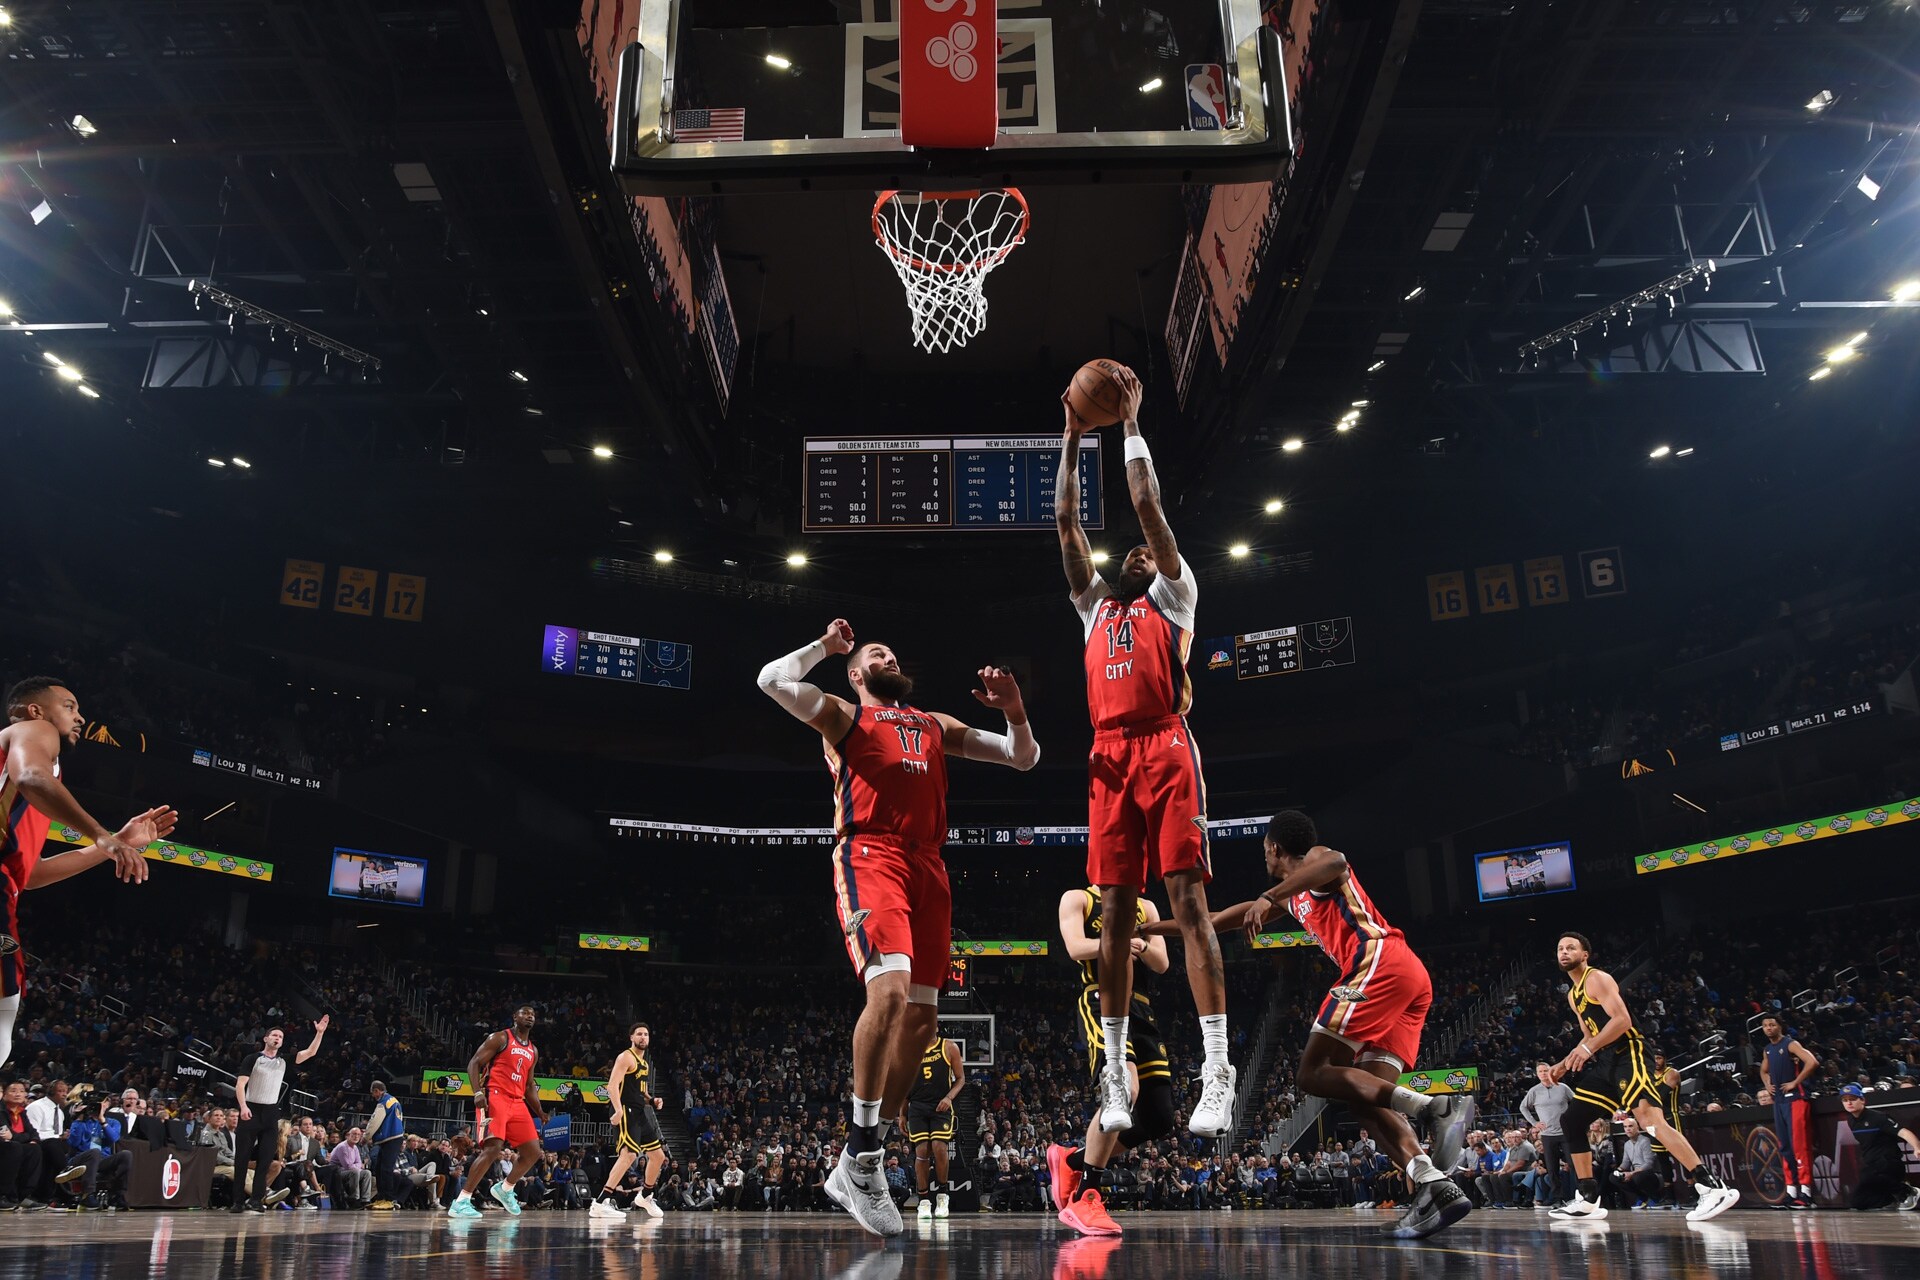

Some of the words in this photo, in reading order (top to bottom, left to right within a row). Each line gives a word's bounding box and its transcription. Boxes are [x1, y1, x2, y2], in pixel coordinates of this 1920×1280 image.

[1195, 116, 1215, 128] NBA
[849, 503, 866, 511] 50.0
[921, 502, 939, 510] 40.0
[998, 501, 1015, 509] 50.0
[849, 515, 866, 523] 25.0
[999, 513, 1015, 521] 66.7
[1589, 557, 1615, 587] 6
[285, 577, 319, 602] 42
[1533, 574, 1560, 600] 13
[338, 583, 371, 609] 24
[1484, 581, 1511, 607] 14
[392, 591, 418, 615] 17
[1435, 590, 1461, 615] 16
[609, 635, 632, 644] TRACKER
[1105, 619, 1134, 658] 14
[1250, 632, 1265, 640] SHOT
[1265, 628, 1289, 638] TRACKER
[552, 630, 568, 670] xfinity
[598, 645, 610, 653] 7/11
[1256, 643, 1270, 651] 4/10
[1258, 654, 1268, 662] 1/4
[595, 666, 607, 674] 0/0
[1106, 659, 1133, 680] CITY
[1257, 665, 1269, 673] 0/0
[1746, 730, 1765, 741] LOU
[1768, 725, 1779, 736] 75
[1791, 718, 1813, 729] MIA-FL
[1814, 714, 1826, 724] 71
[1833, 709, 1847, 718] H2
[1851, 702, 1871, 714] 1:14
[894, 724, 923, 754] 17
[902, 758, 928, 775] CITY
[218, 758, 234, 768] LOU
[237, 762, 246, 772] 75
[256, 768, 274, 779] MIA-FL
[276, 772, 284, 782] 71
[306, 779, 321, 789] 1:14
[617, 828, 622, 836] 3
[767, 837, 782, 845] 50.0
[817, 837, 833, 845] 40.0
[947, 829, 960, 839] 46
[996, 830, 1010, 843] 20
[1217, 828, 1232, 837] 66.7
[1243, 826, 1258, 835] 63.6
[1535, 847, 1561, 856] verizon
[393, 860, 418, 868] verizon
[177, 1064, 207, 1079] betway
[923, 1066, 933, 1079] 5
